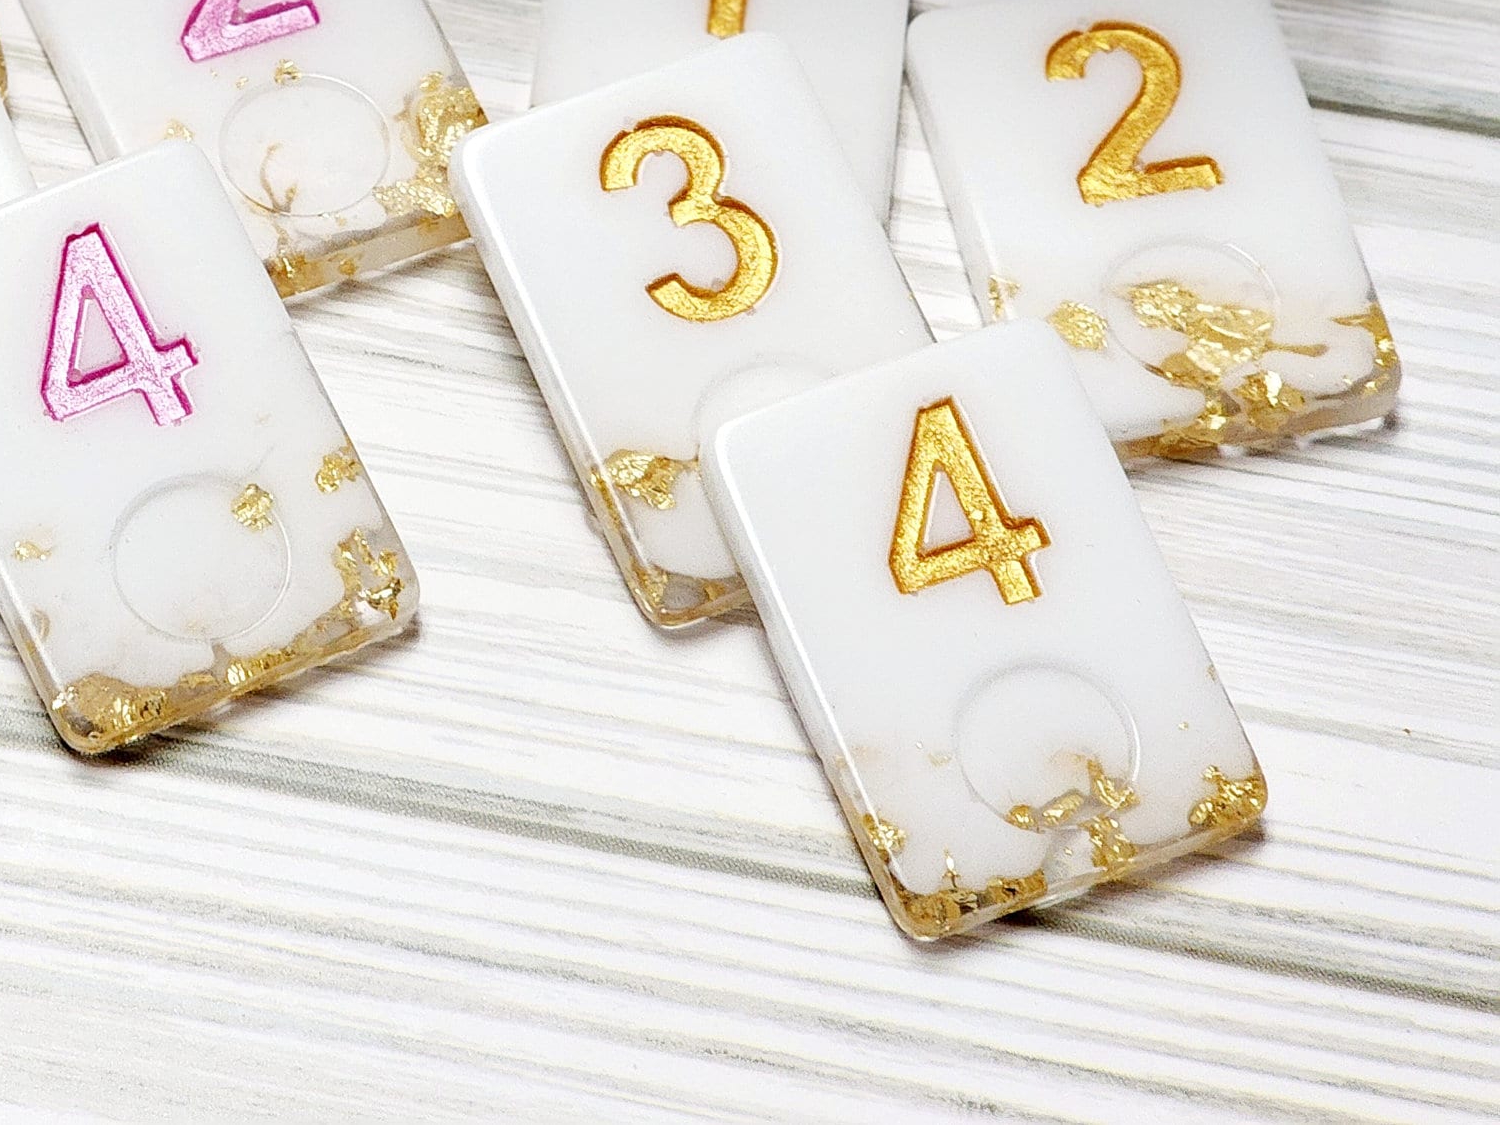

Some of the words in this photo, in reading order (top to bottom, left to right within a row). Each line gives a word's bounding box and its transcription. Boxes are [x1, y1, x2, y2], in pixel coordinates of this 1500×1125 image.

[1045, 20, 1224, 206] 2
[599, 115, 778, 322] 3
[40, 223, 199, 427] 4
[888, 397, 1051, 605] 4
